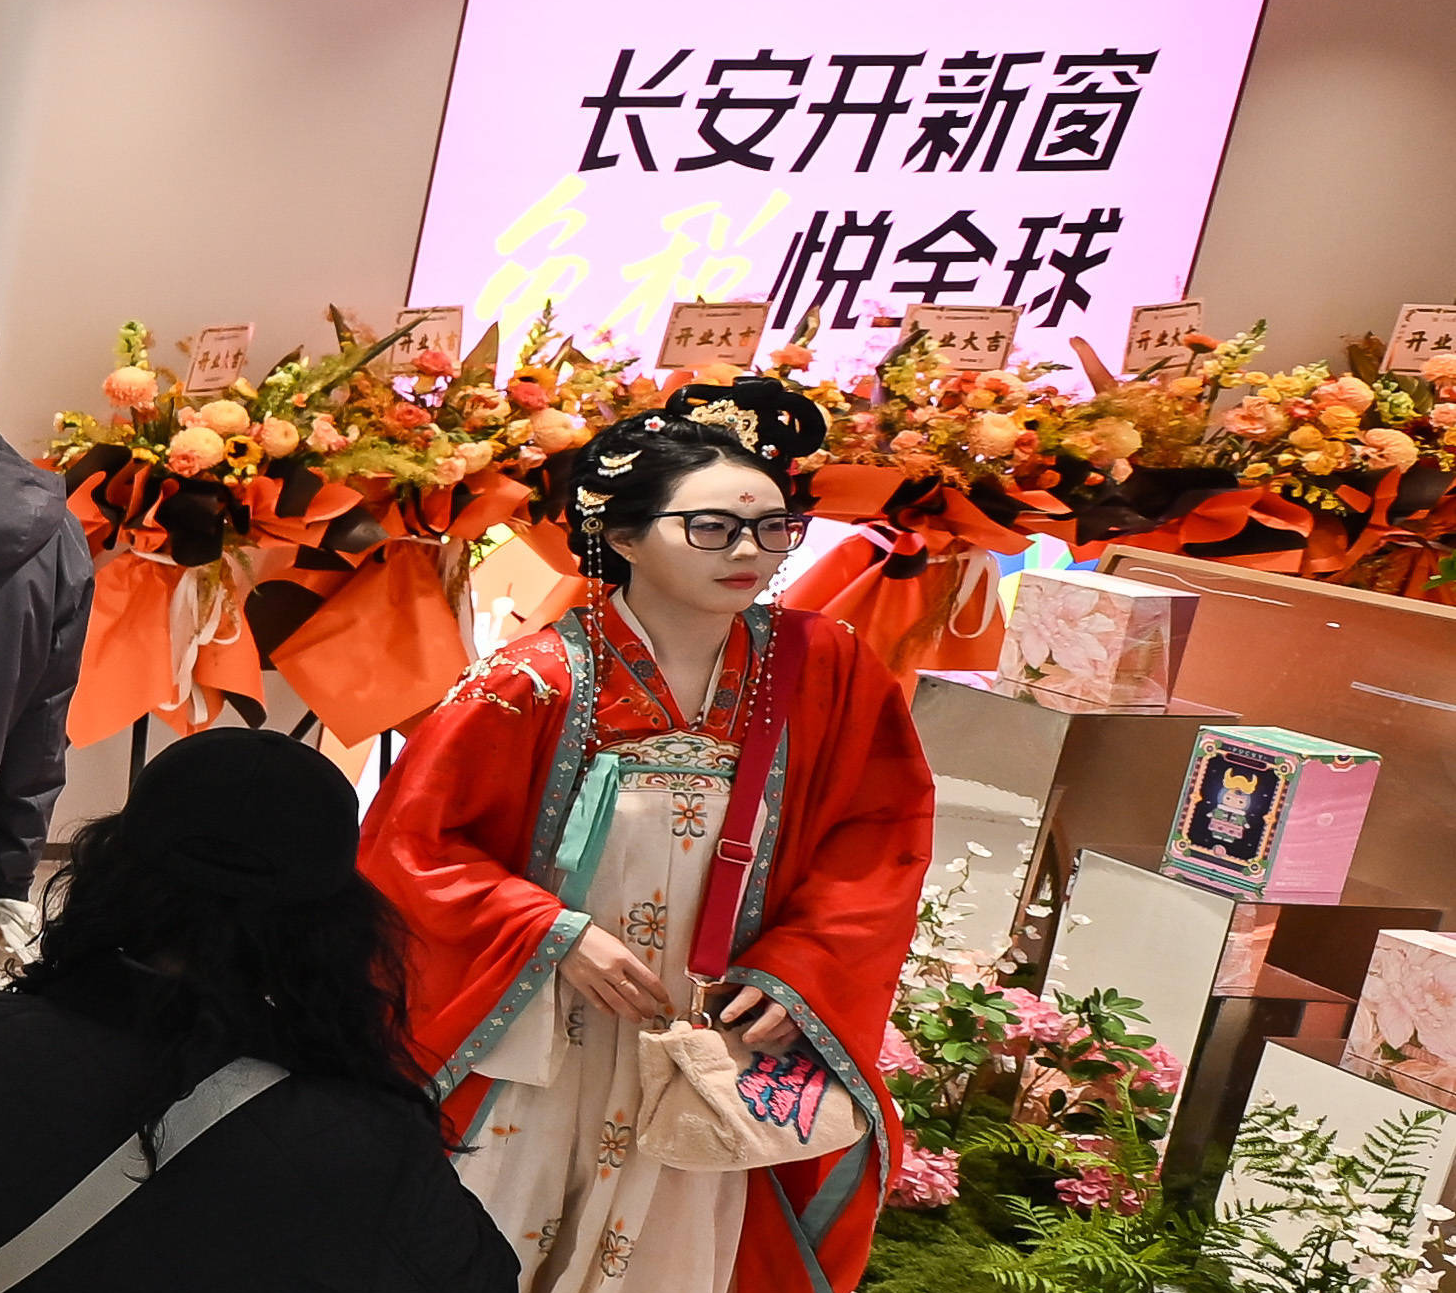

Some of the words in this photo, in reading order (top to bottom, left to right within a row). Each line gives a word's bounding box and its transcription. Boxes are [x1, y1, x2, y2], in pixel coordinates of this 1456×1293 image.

[577, 48, 1162, 173] 长安开新窗
[674, 326, 757, 349] 开业大吉
[924, 331, 1008, 353] 业大吉
